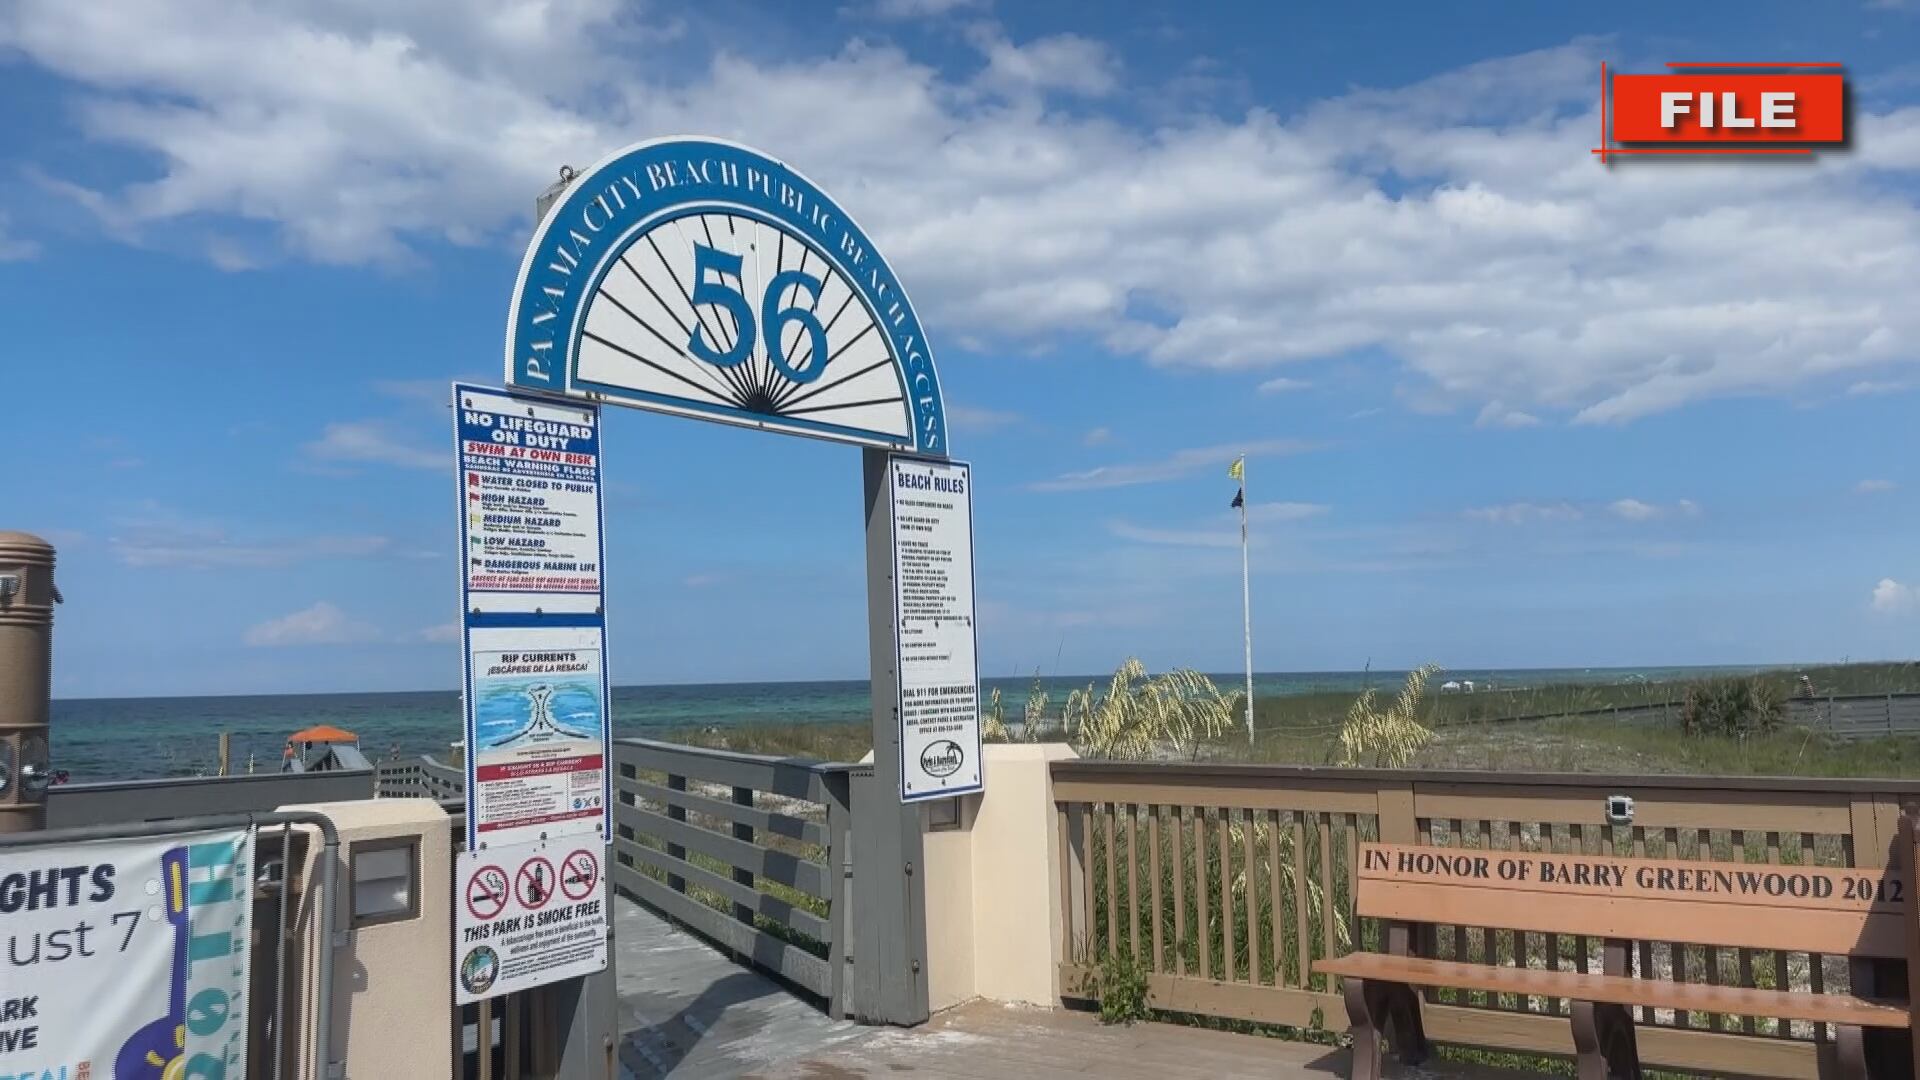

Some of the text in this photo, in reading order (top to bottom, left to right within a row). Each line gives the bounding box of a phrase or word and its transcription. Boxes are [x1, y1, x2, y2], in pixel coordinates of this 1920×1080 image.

[527, 158, 938, 450] PANAMA CITY BEACH PUBLIC BEACH ACCESS
[687, 239, 828, 385] 56
[464, 411, 592, 440] NO LIFEGUARD
[491, 429, 569, 450] ON DUTY
[468, 441, 593, 465] SWIM AT OWN RISK
[464, 455, 595, 476] BEACH WARNING FLAGS
[481, 474, 594, 494] WATER CLOSED TO PUBLIC
[898, 472, 964, 494] BEACH RULES
[481, 492, 545, 506] HIGH HAZARD
[483, 513, 522, 525] MEDIUM
[525, 516, 561, 527] HAZARD
[483, 535, 545, 548] LOW HAZARD
[485, 559, 540, 570] DANGEROUS
[543, 561, 577, 572] MARINE
[580, 562, 596, 572] LIFE
[502, 652, 576, 663] RIP CURRENTS
[533, 664, 543, 673] DE
[545, 664, 555, 672] LA
[903, 685, 975, 698] DIAL 911 FOR EMERGENCIES
[925, 698, 949, 706] INFORMATION
[953, 714, 974, 722] RECREATION
[1364, 848, 1905, 903] IN HONOR OF BARRY GREENWOOD 2012
[0, 863, 116, 914] GHTS
[464, 924, 490, 942] THIS
[491, 916, 521, 936] PARK
[523, 913, 535, 929] IS
[537, 905, 573, 926] SMOKE
[575, 899, 601, 918] FREE
[111, 911, 142, 953] 7
